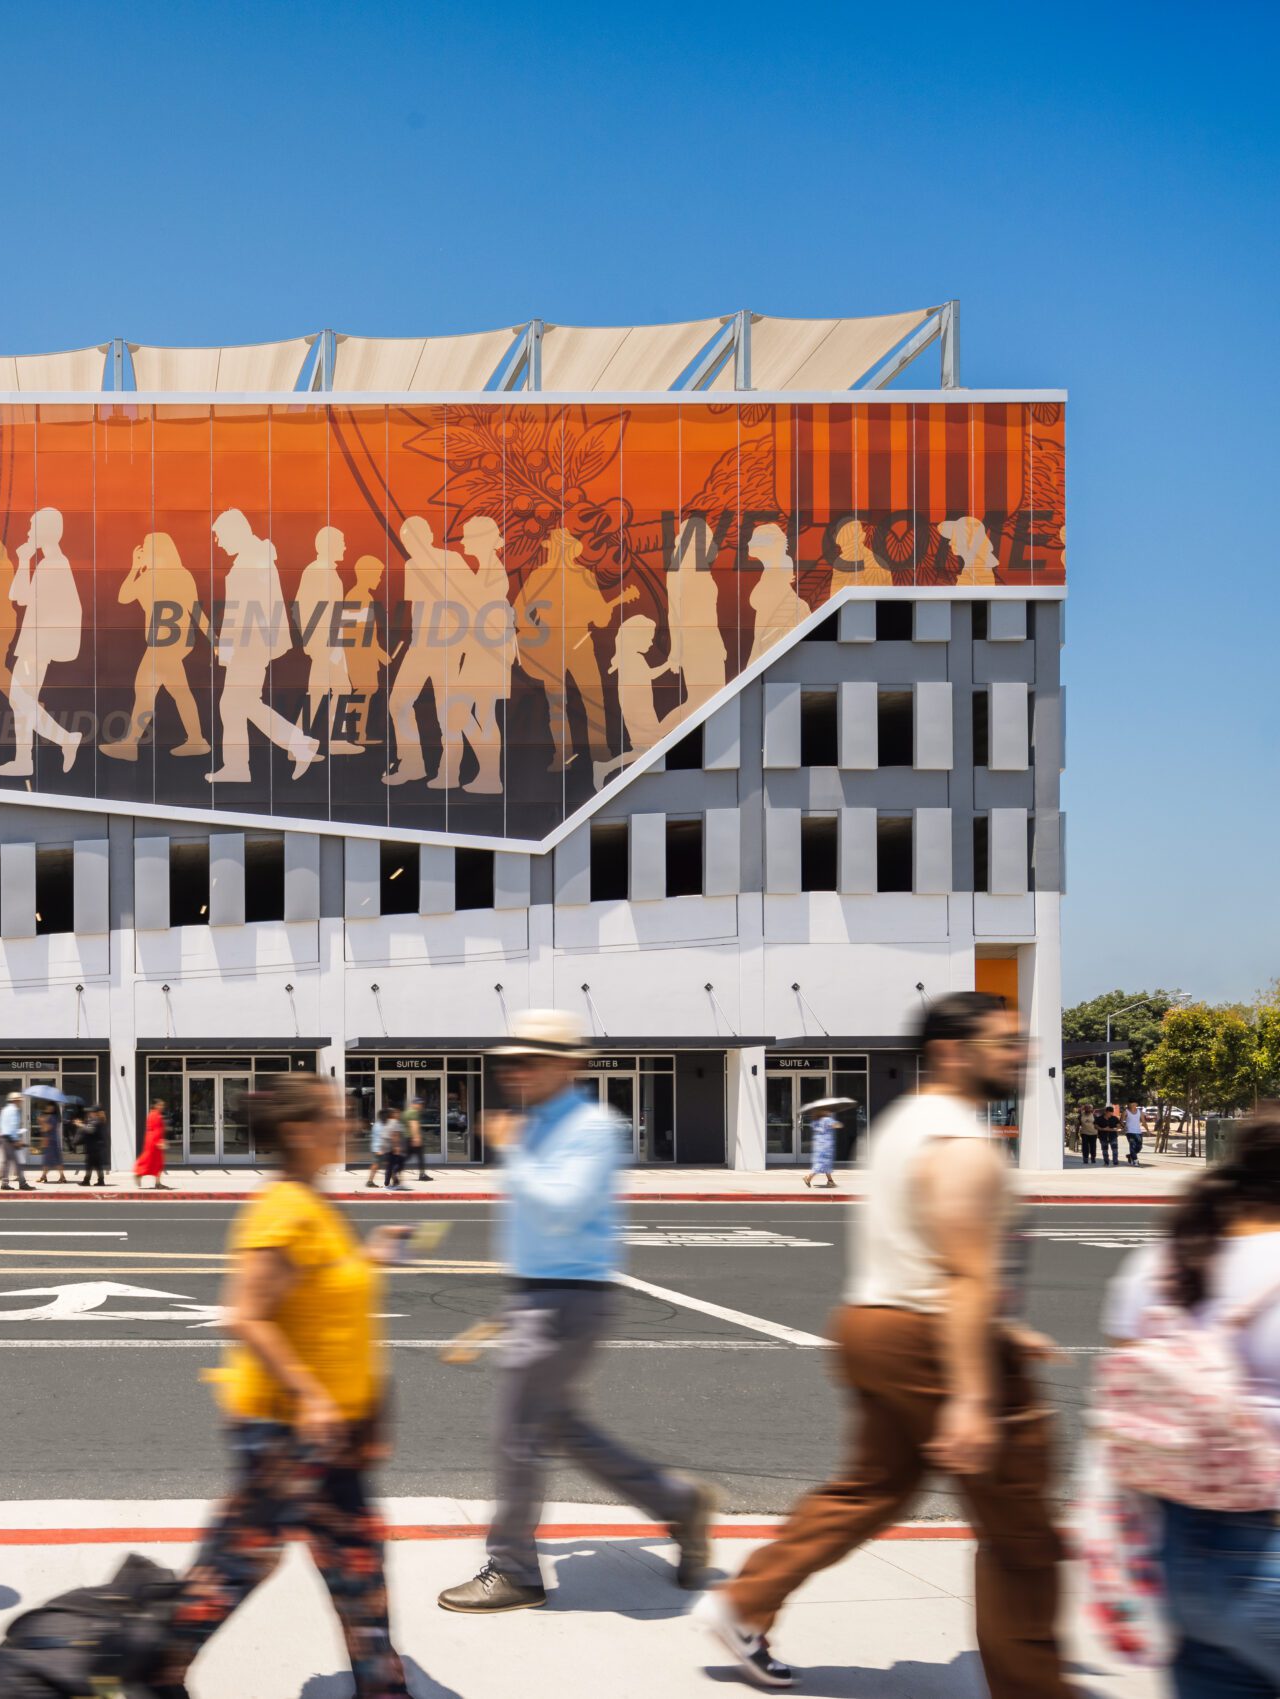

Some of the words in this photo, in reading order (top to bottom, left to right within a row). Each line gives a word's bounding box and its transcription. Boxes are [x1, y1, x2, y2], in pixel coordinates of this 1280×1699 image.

[148, 600, 553, 648] BIENVENIDOS
[11, 1061, 35, 1069] SUITE
[396, 1060, 420, 1068] SUITE
[421, 1060, 427, 1068] C
[588, 1060, 611, 1068] SUITE
[779, 1059, 803, 1067] SUITE
[804, 1059, 810, 1067] A
